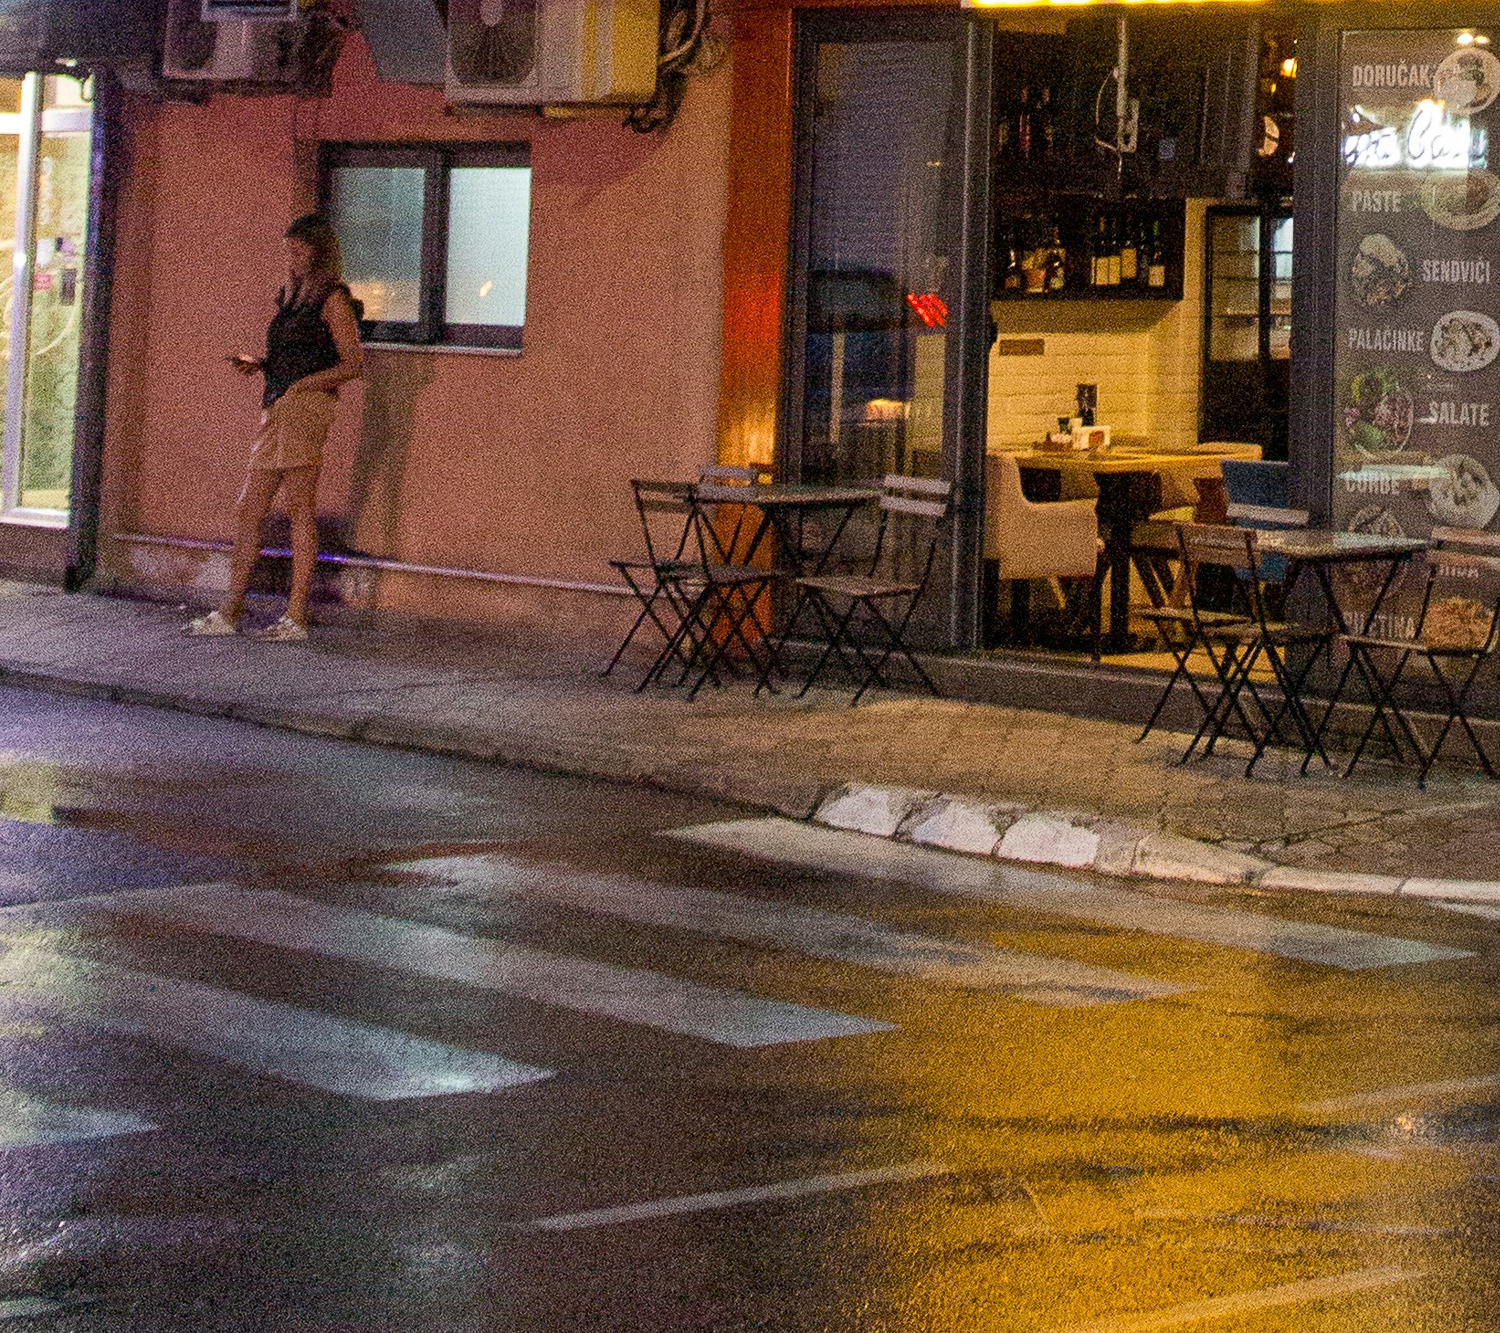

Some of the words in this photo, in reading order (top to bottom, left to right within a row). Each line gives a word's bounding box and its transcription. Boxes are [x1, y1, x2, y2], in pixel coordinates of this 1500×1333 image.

[1352, 59, 1432, 87] DORUČAK
[1352, 190, 1402, 213] PASTE
[1428, 401, 1491, 427] SALATE
